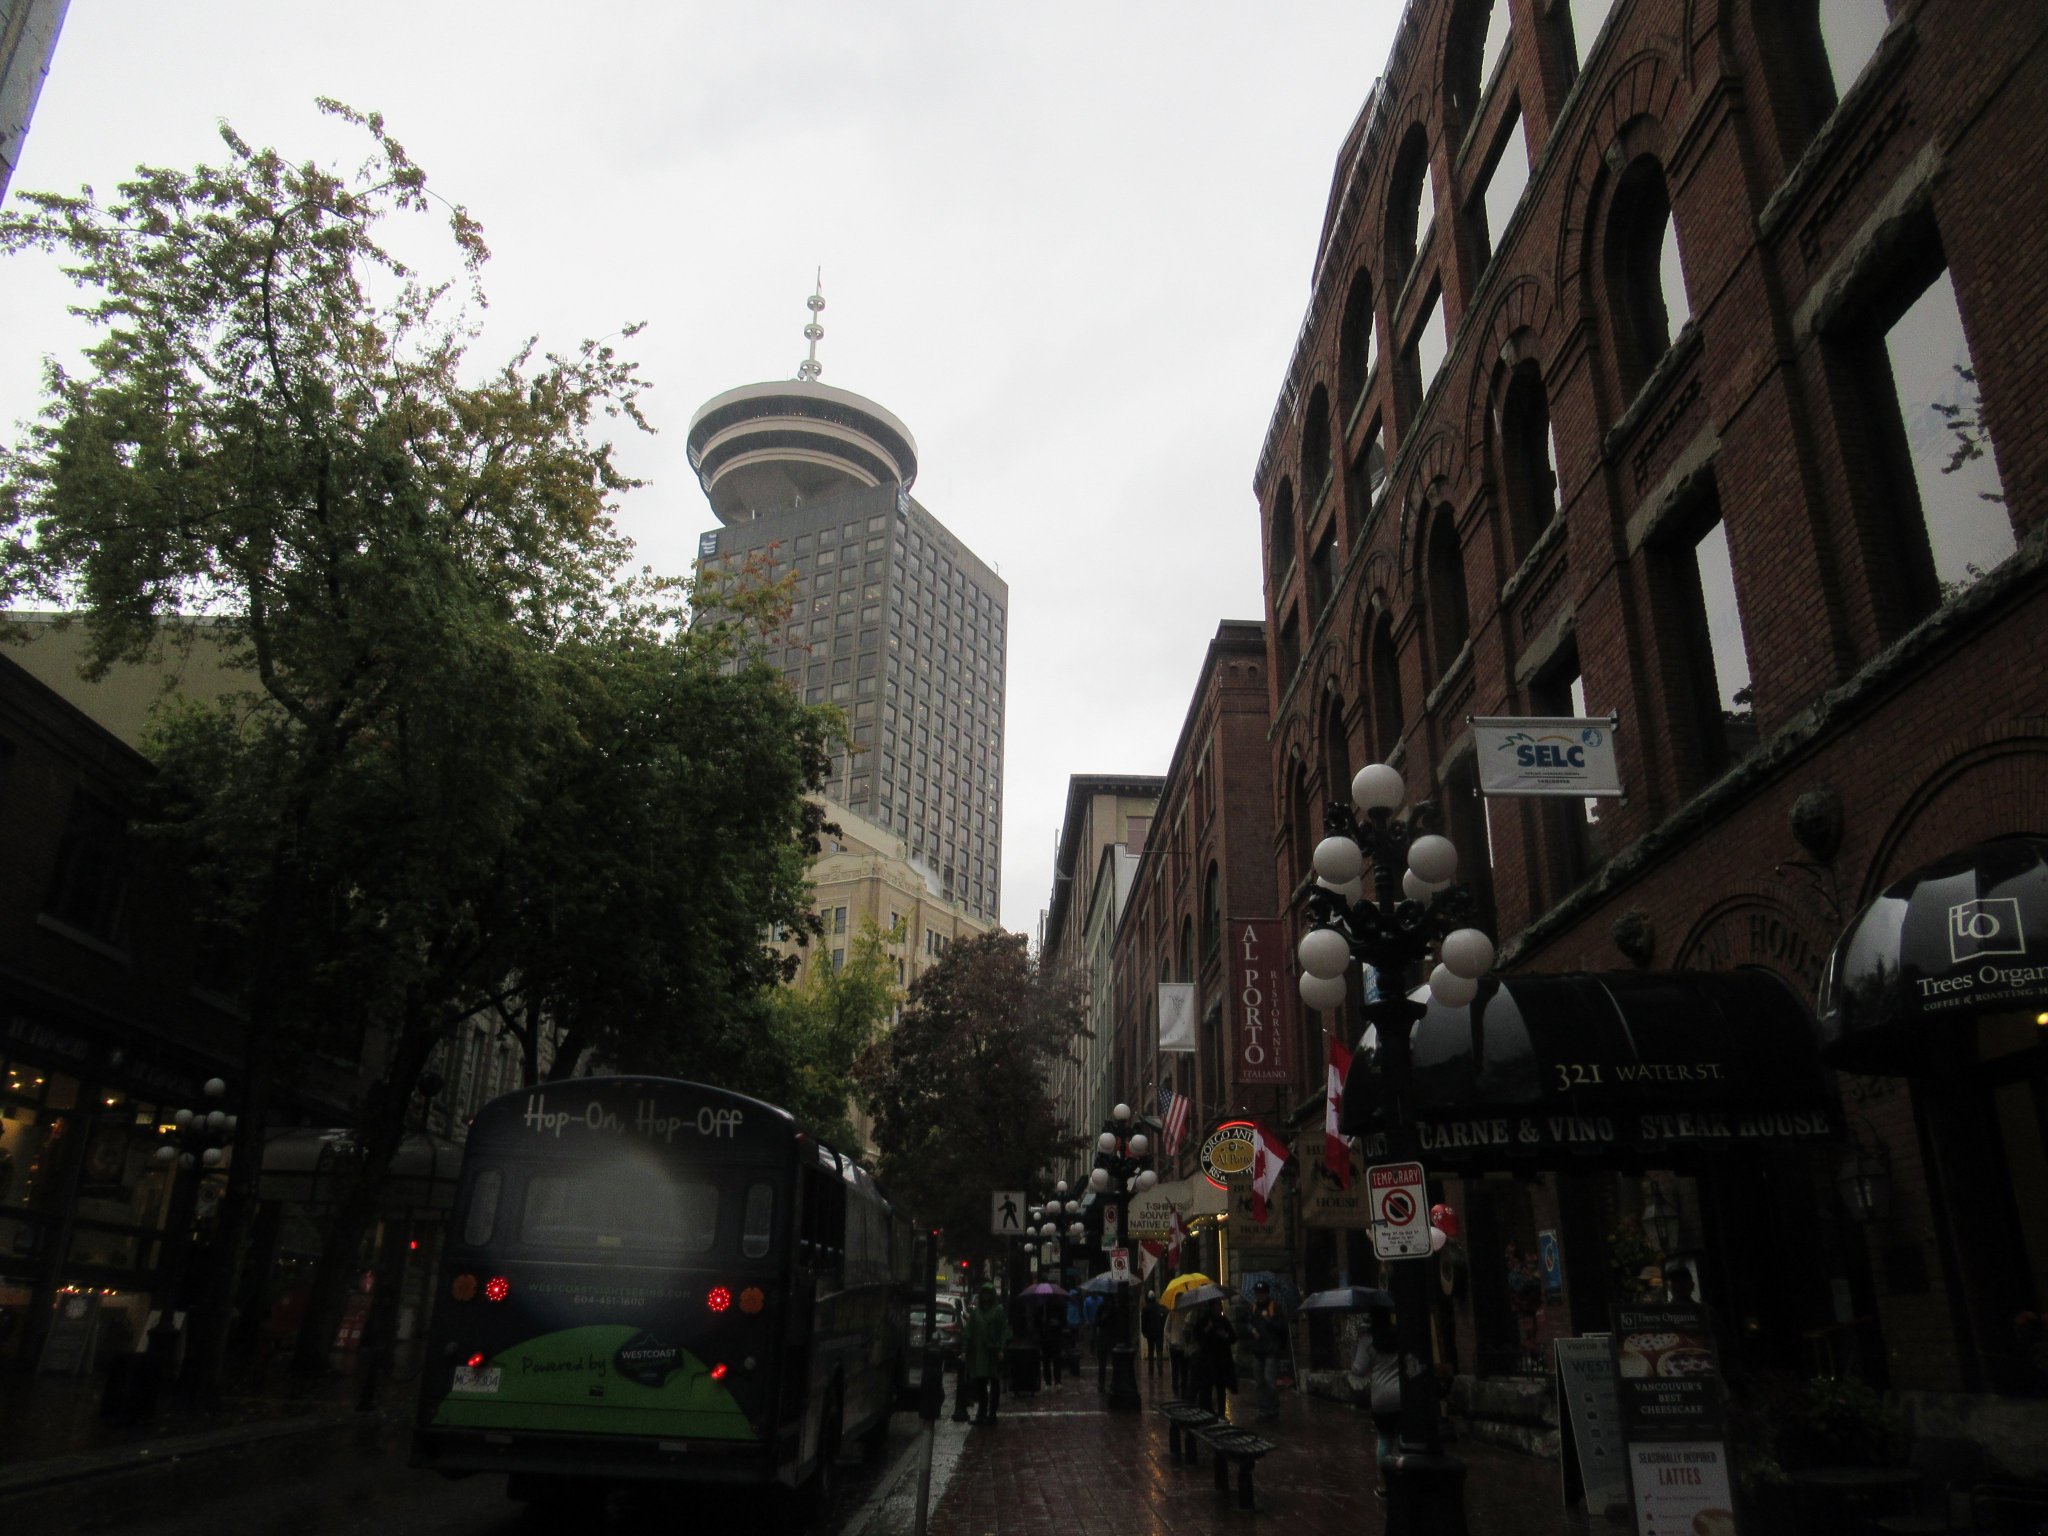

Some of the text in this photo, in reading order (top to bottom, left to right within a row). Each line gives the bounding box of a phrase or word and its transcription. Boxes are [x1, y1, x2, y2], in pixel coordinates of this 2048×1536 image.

[1517, 745, 1585, 767] SELC
[1242, 924, 1259, 960] AL
[1916, 974, 1974, 997] Trees
[1923, 997, 1960, 1011] COFFEE
[1975, 987, 2033, 1002] ROASTING
[1243, 969, 1265, 1065] PORTO
[1270, 970, 1281, 1066] RISTORANTE
[1243, 1070, 1286, 1079] ITALIANO
[1554, 1063, 1725, 1091] 321 WATER ST.
[636, 1099, 744, 1142] Hop-Off
[1416, 1110, 1830, 1150] CARNE & VINO STEAK HOUSE
[1203, 1130, 1230, 1162] BORGO
[1317, 1198, 1359, 1207] HOUSE
[1130, 1220, 1160, 1229] NATIVE
[1140, 1211, 1170, 1220] SOUVE
[622, 1348, 677, 1359] WESTCOAST
[522, 1354, 607, 1377] Powered by
[1634, 1382, 1703, 1391] VANCOUVER'S
[1658, 1394, 1682, 1403] BEST
[1640, 1405, 1704, 1415] CHEESECAKE
[1638, 1452, 1682, 1464] SEASONALLY
[1659, 1467, 1702, 1485] LATTES
